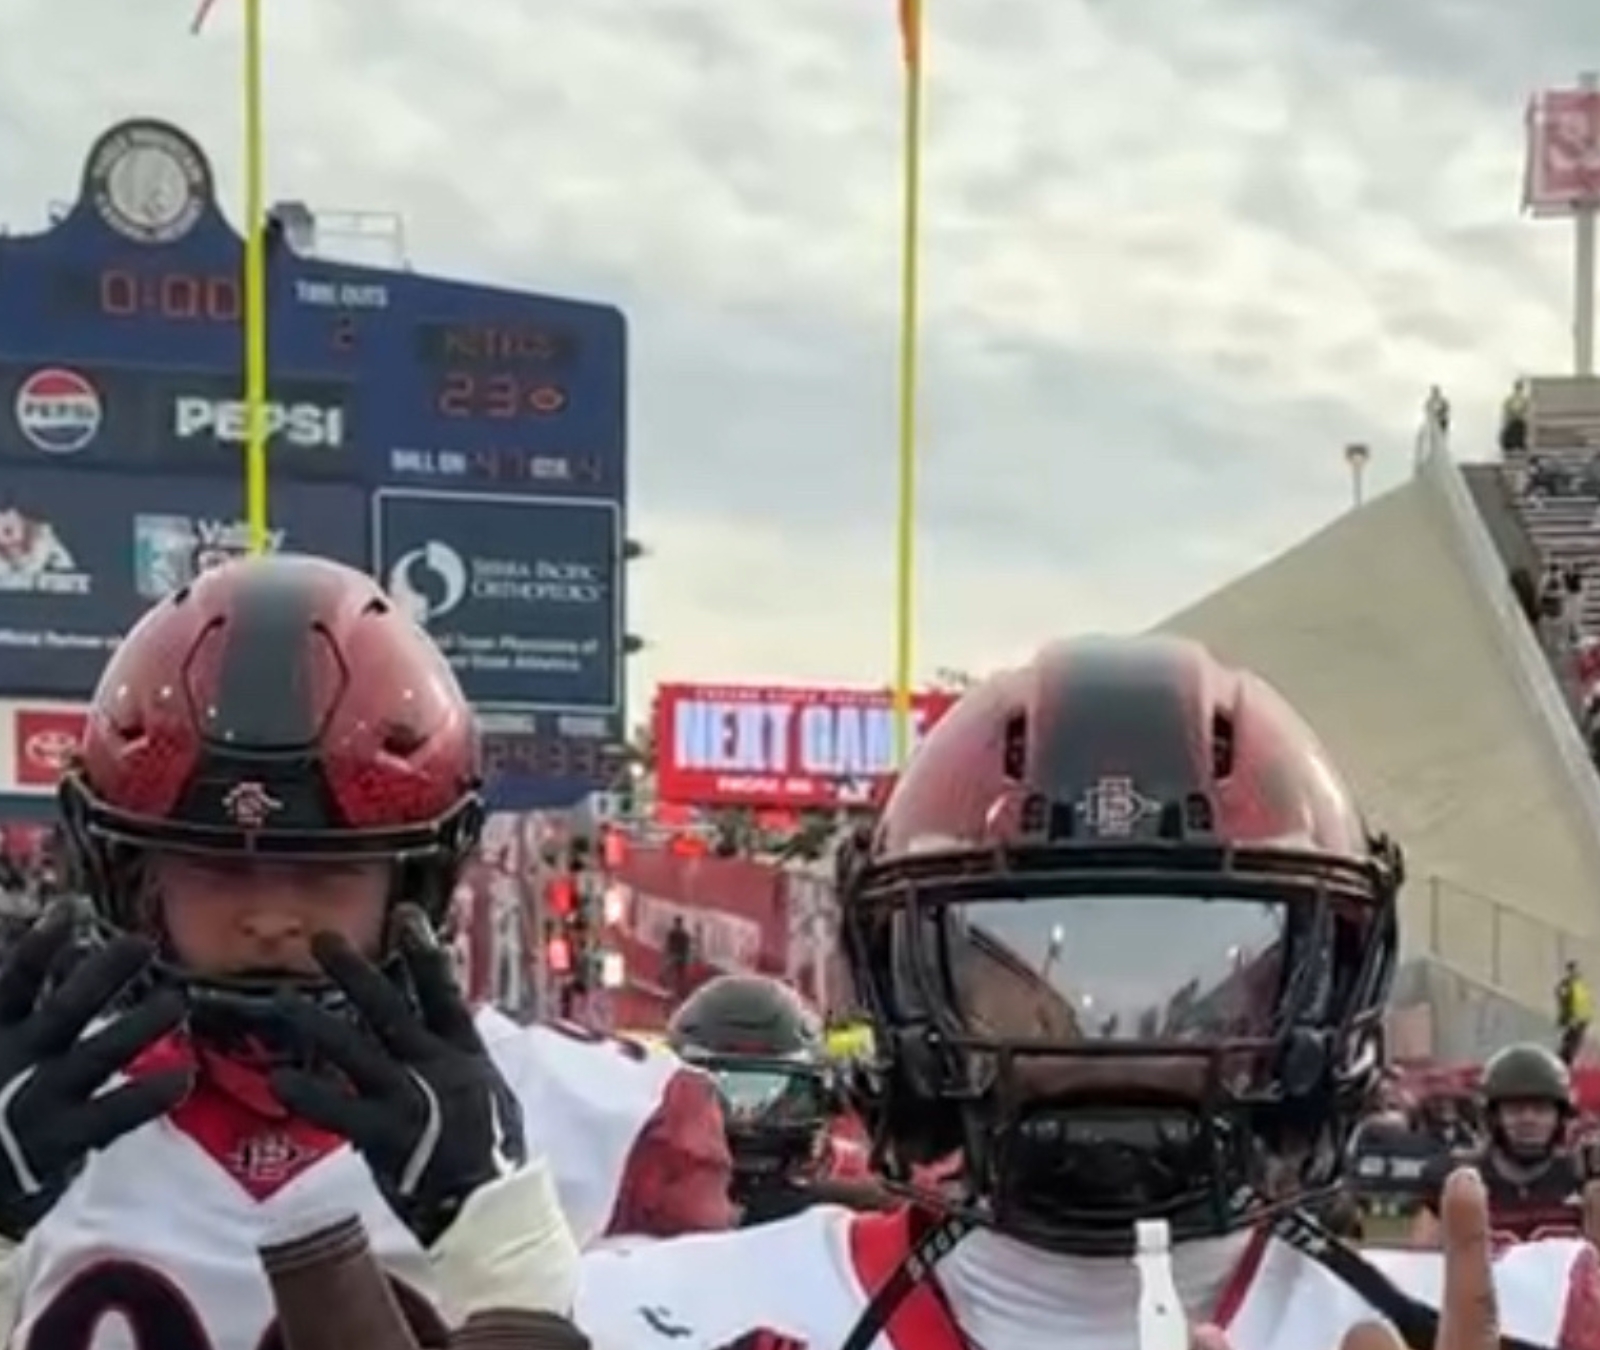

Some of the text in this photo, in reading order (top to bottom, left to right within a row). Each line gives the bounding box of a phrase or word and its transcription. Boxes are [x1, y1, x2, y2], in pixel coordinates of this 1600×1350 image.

[101, 269, 243, 318] 0:00
[438, 370, 518, 418] 23
[174, 395, 344, 447] PEPSI
[674, 700, 794, 772] NEXT
